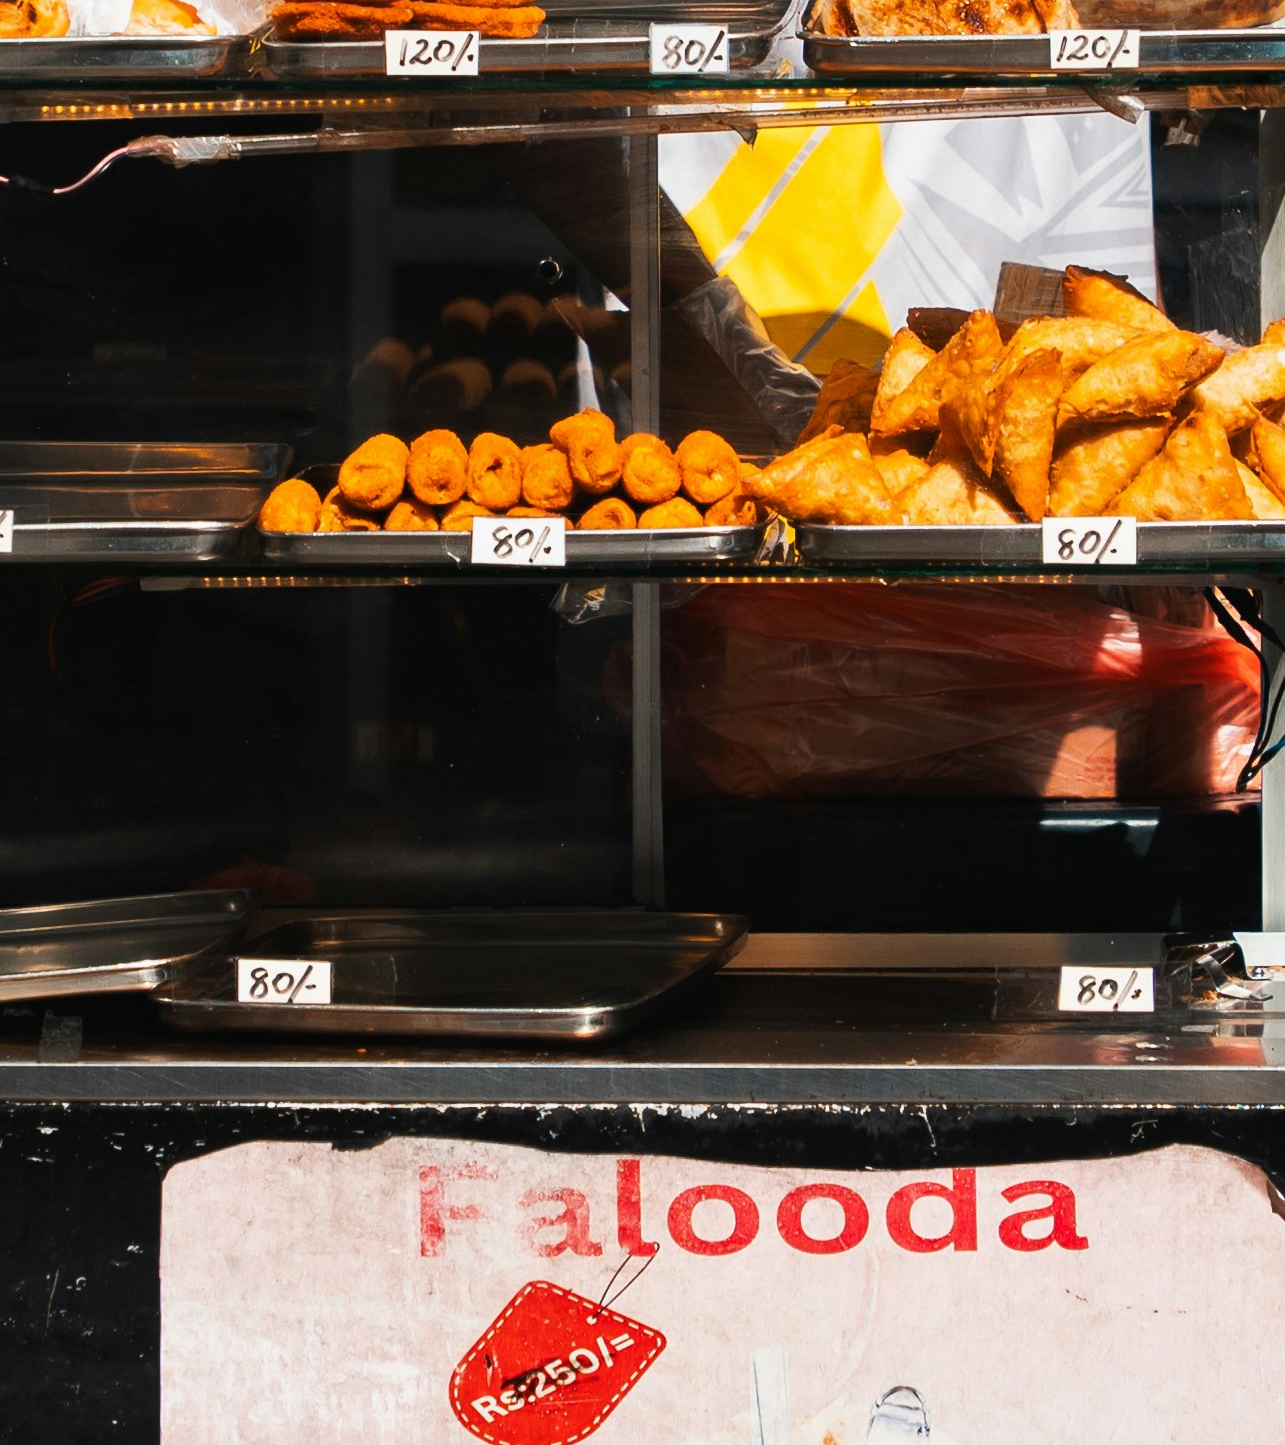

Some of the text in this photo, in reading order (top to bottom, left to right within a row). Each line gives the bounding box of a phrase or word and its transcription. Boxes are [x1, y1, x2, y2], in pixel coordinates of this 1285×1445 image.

[662, 30, 726, 72] 80/-
[1056, 30, 1130, 69] 120/-
[249, 964, 318, 1004] 80/-
[419, 1158, 1089, 1258] Falooda
